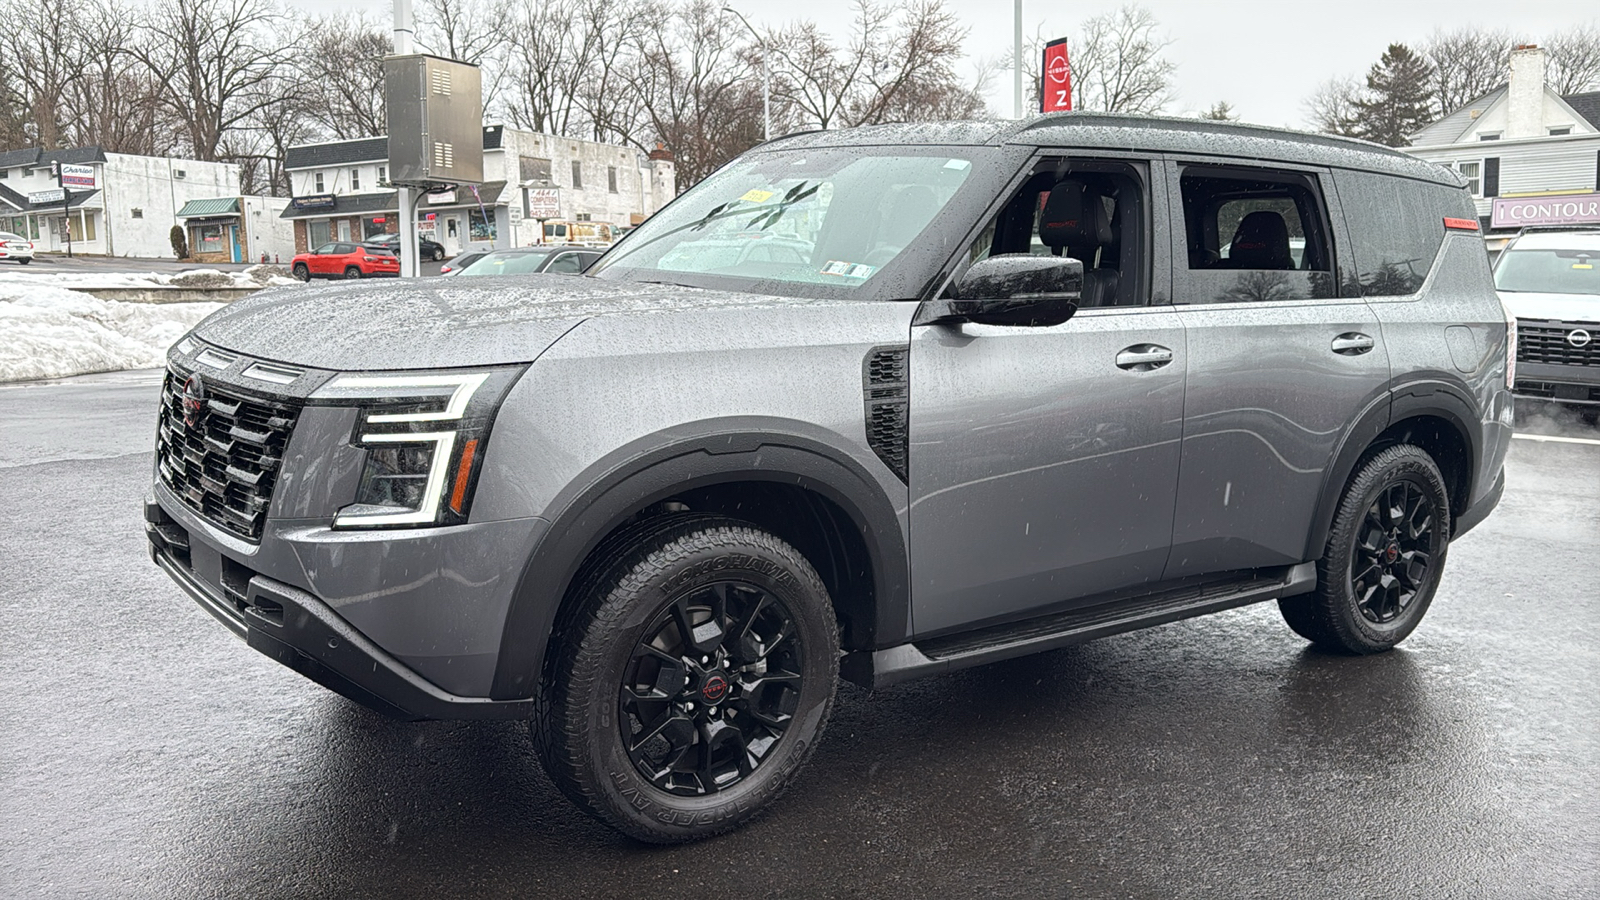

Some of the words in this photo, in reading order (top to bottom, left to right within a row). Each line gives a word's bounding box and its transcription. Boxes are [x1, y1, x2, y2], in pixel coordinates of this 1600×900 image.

[62, 166, 93, 174] Charles
[530, 196, 558, 204] COMPUTERS
[1510, 202, 1598, 220] CONTOUR
[660, 553, 799, 594] YOKOHAMA
